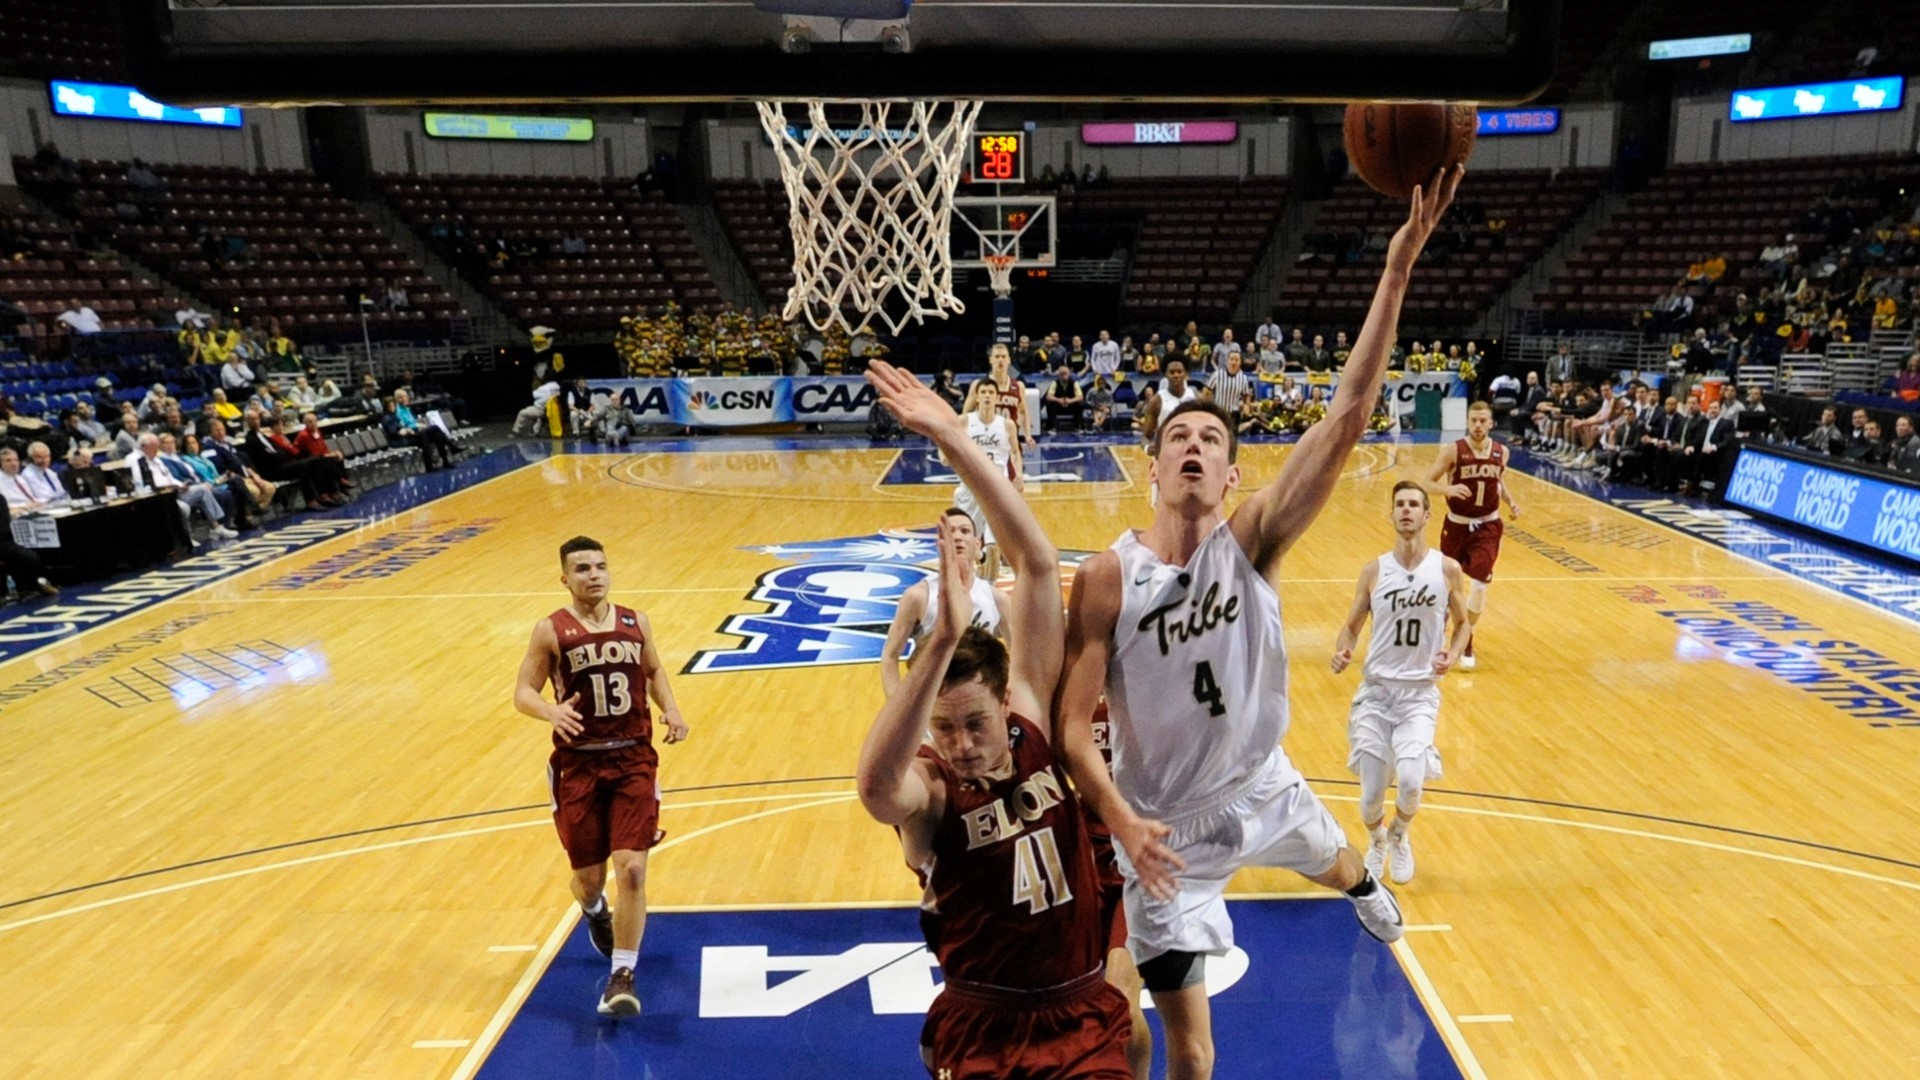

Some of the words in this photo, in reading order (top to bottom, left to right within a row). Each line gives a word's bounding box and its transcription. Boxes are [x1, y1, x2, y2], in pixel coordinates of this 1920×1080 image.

[980, 136, 1018, 153] 12:58
[1134, 122, 1185, 143] BB&T
[976, 152, 1012, 178] 28
[721, 390, 774, 410] CSN
[972, 434, 1000, 446] Tribe
[1460, 464, 1501, 479] ELON
[1738, 453, 1788, 484] CAMPING
[1475, 481, 1485, 506] 1
[1729, 473, 1779, 510] WORLD
[1801, 469, 1861, 504] CAMPING
[1793, 492, 1852, 531] WORLD
[0, 518, 376, 642] CHARLESTON
[1383, 584, 1437, 612] Tribe
[1137, 580, 1240, 656] Tribe
[1708, 600, 1825, 632] HIGH
[1394, 618, 1421, 647] 10
[565, 640, 642, 674] ELON
[588, 671, 632, 718] 13
[1193, 659, 1227, 718] 4
[961, 764, 1066, 851] ELON
[1012, 826, 1074, 916] 41
